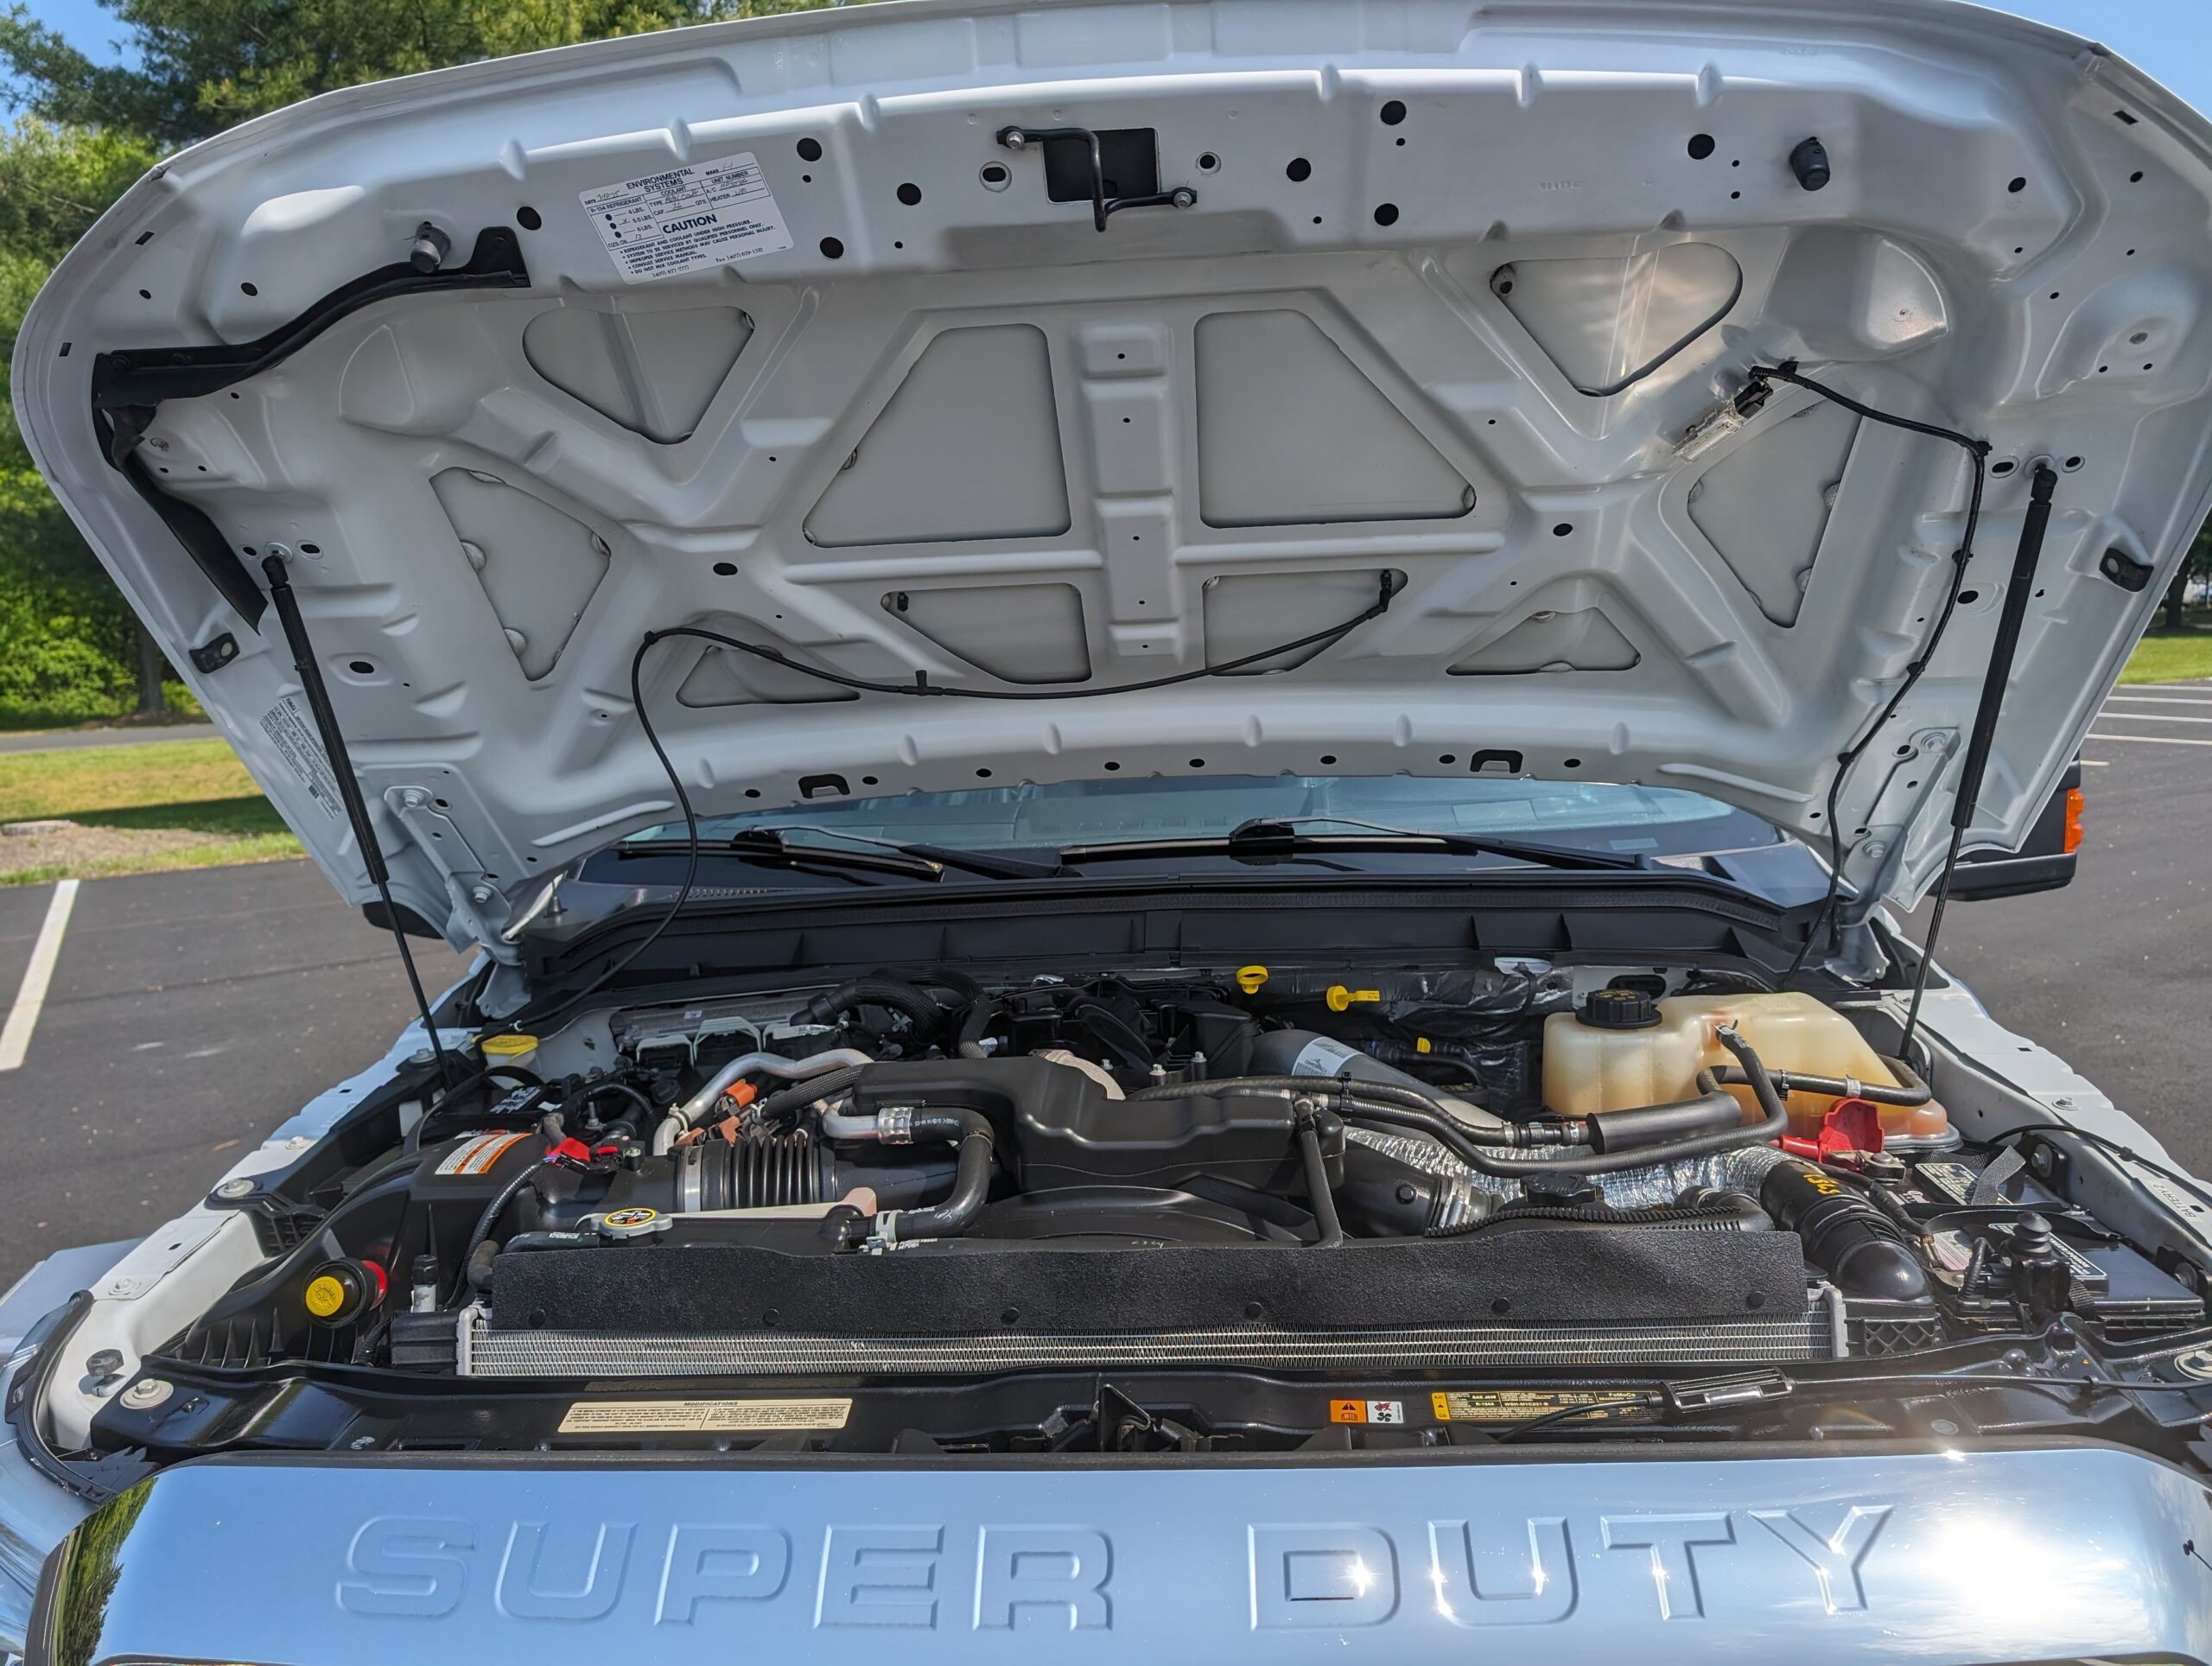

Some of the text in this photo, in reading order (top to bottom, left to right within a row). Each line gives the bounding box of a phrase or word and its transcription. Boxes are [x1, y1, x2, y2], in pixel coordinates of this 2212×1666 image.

[626, 168, 695, 189] ENVIRONMENTAL
[725, 171, 749, 181] NUMBER
[644, 178, 683, 192] SYSTEMS
[660, 186, 687, 196] COOLANT
[606, 197, 643, 209] REFRIGERANT
[709, 194, 731, 202] HEATER
[662, 214, 718, 234] CAUTION
[623, 242, 656, 253] REFRIGERANT
[669, 233, 694, 242] COOLANT
[662, 241, 684, 250] SERVICED
[693, 233, 718, 243] QUALIFIED
[719, 226, 748, 236] PERSONNEL
[629, 254, 654, 264] IMPROPER
[654, 249, 675, 258] SERVICE
[675, 244, 699, 252] METHODS
[729, 230, 755, 240] PERSONAL
[632, 260, 654, 269] CONSULT
[666, 258, 690, 266] COOLANT
[2158, 1189, 2197, 1218] BATTERY
[335, 1504, 1895, 1632] SUPER DUTY
